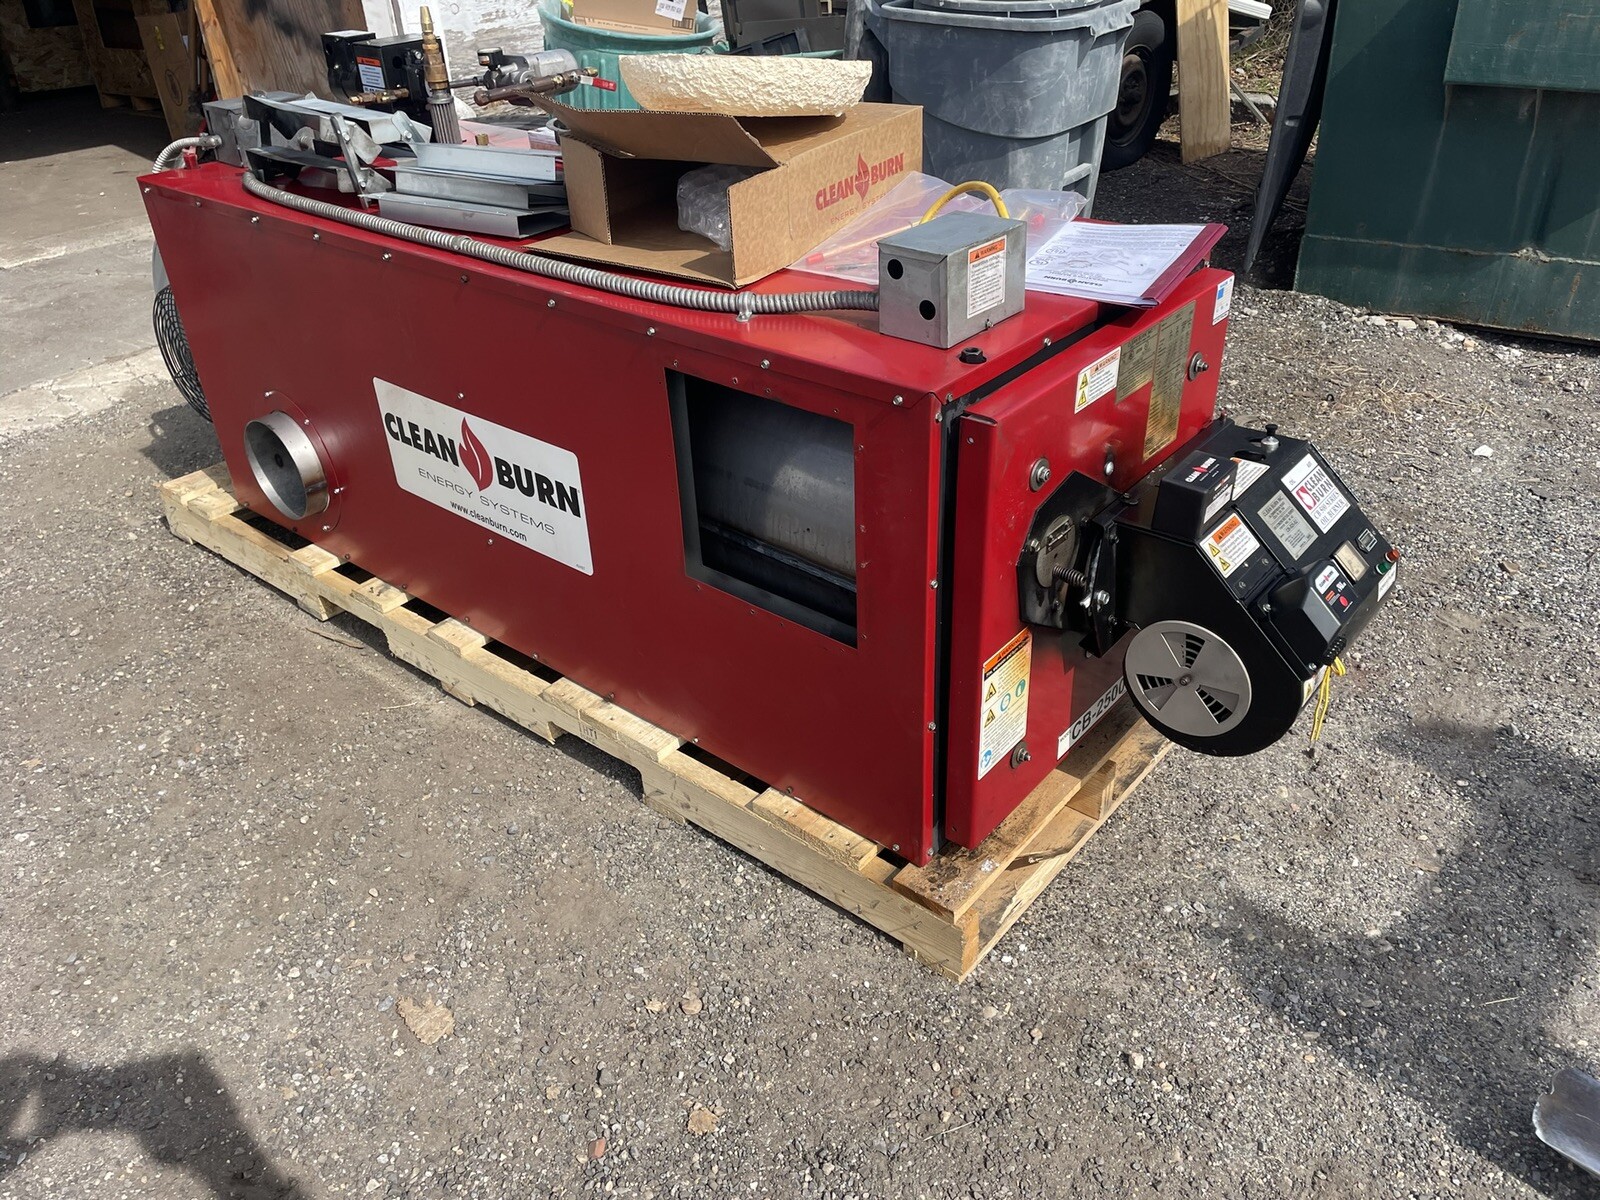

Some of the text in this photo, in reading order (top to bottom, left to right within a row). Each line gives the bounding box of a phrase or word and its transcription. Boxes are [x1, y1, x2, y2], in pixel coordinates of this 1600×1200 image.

[816, 152, 904, 211] CLEAN BURN
[830, 207, 858, 224] ENERGY
[384, 412, 582, 518] CLEAN BURN
[1304, 468, 1326, 492] CLEAN
[418, 467, 555, 535] ENERGY SYSTEMS
[1311, 478, 1334, 503] BURN
[450, 500, 527, 542] www.cleanburn.com
[1072, 679, 1125, 740] CB-2500
